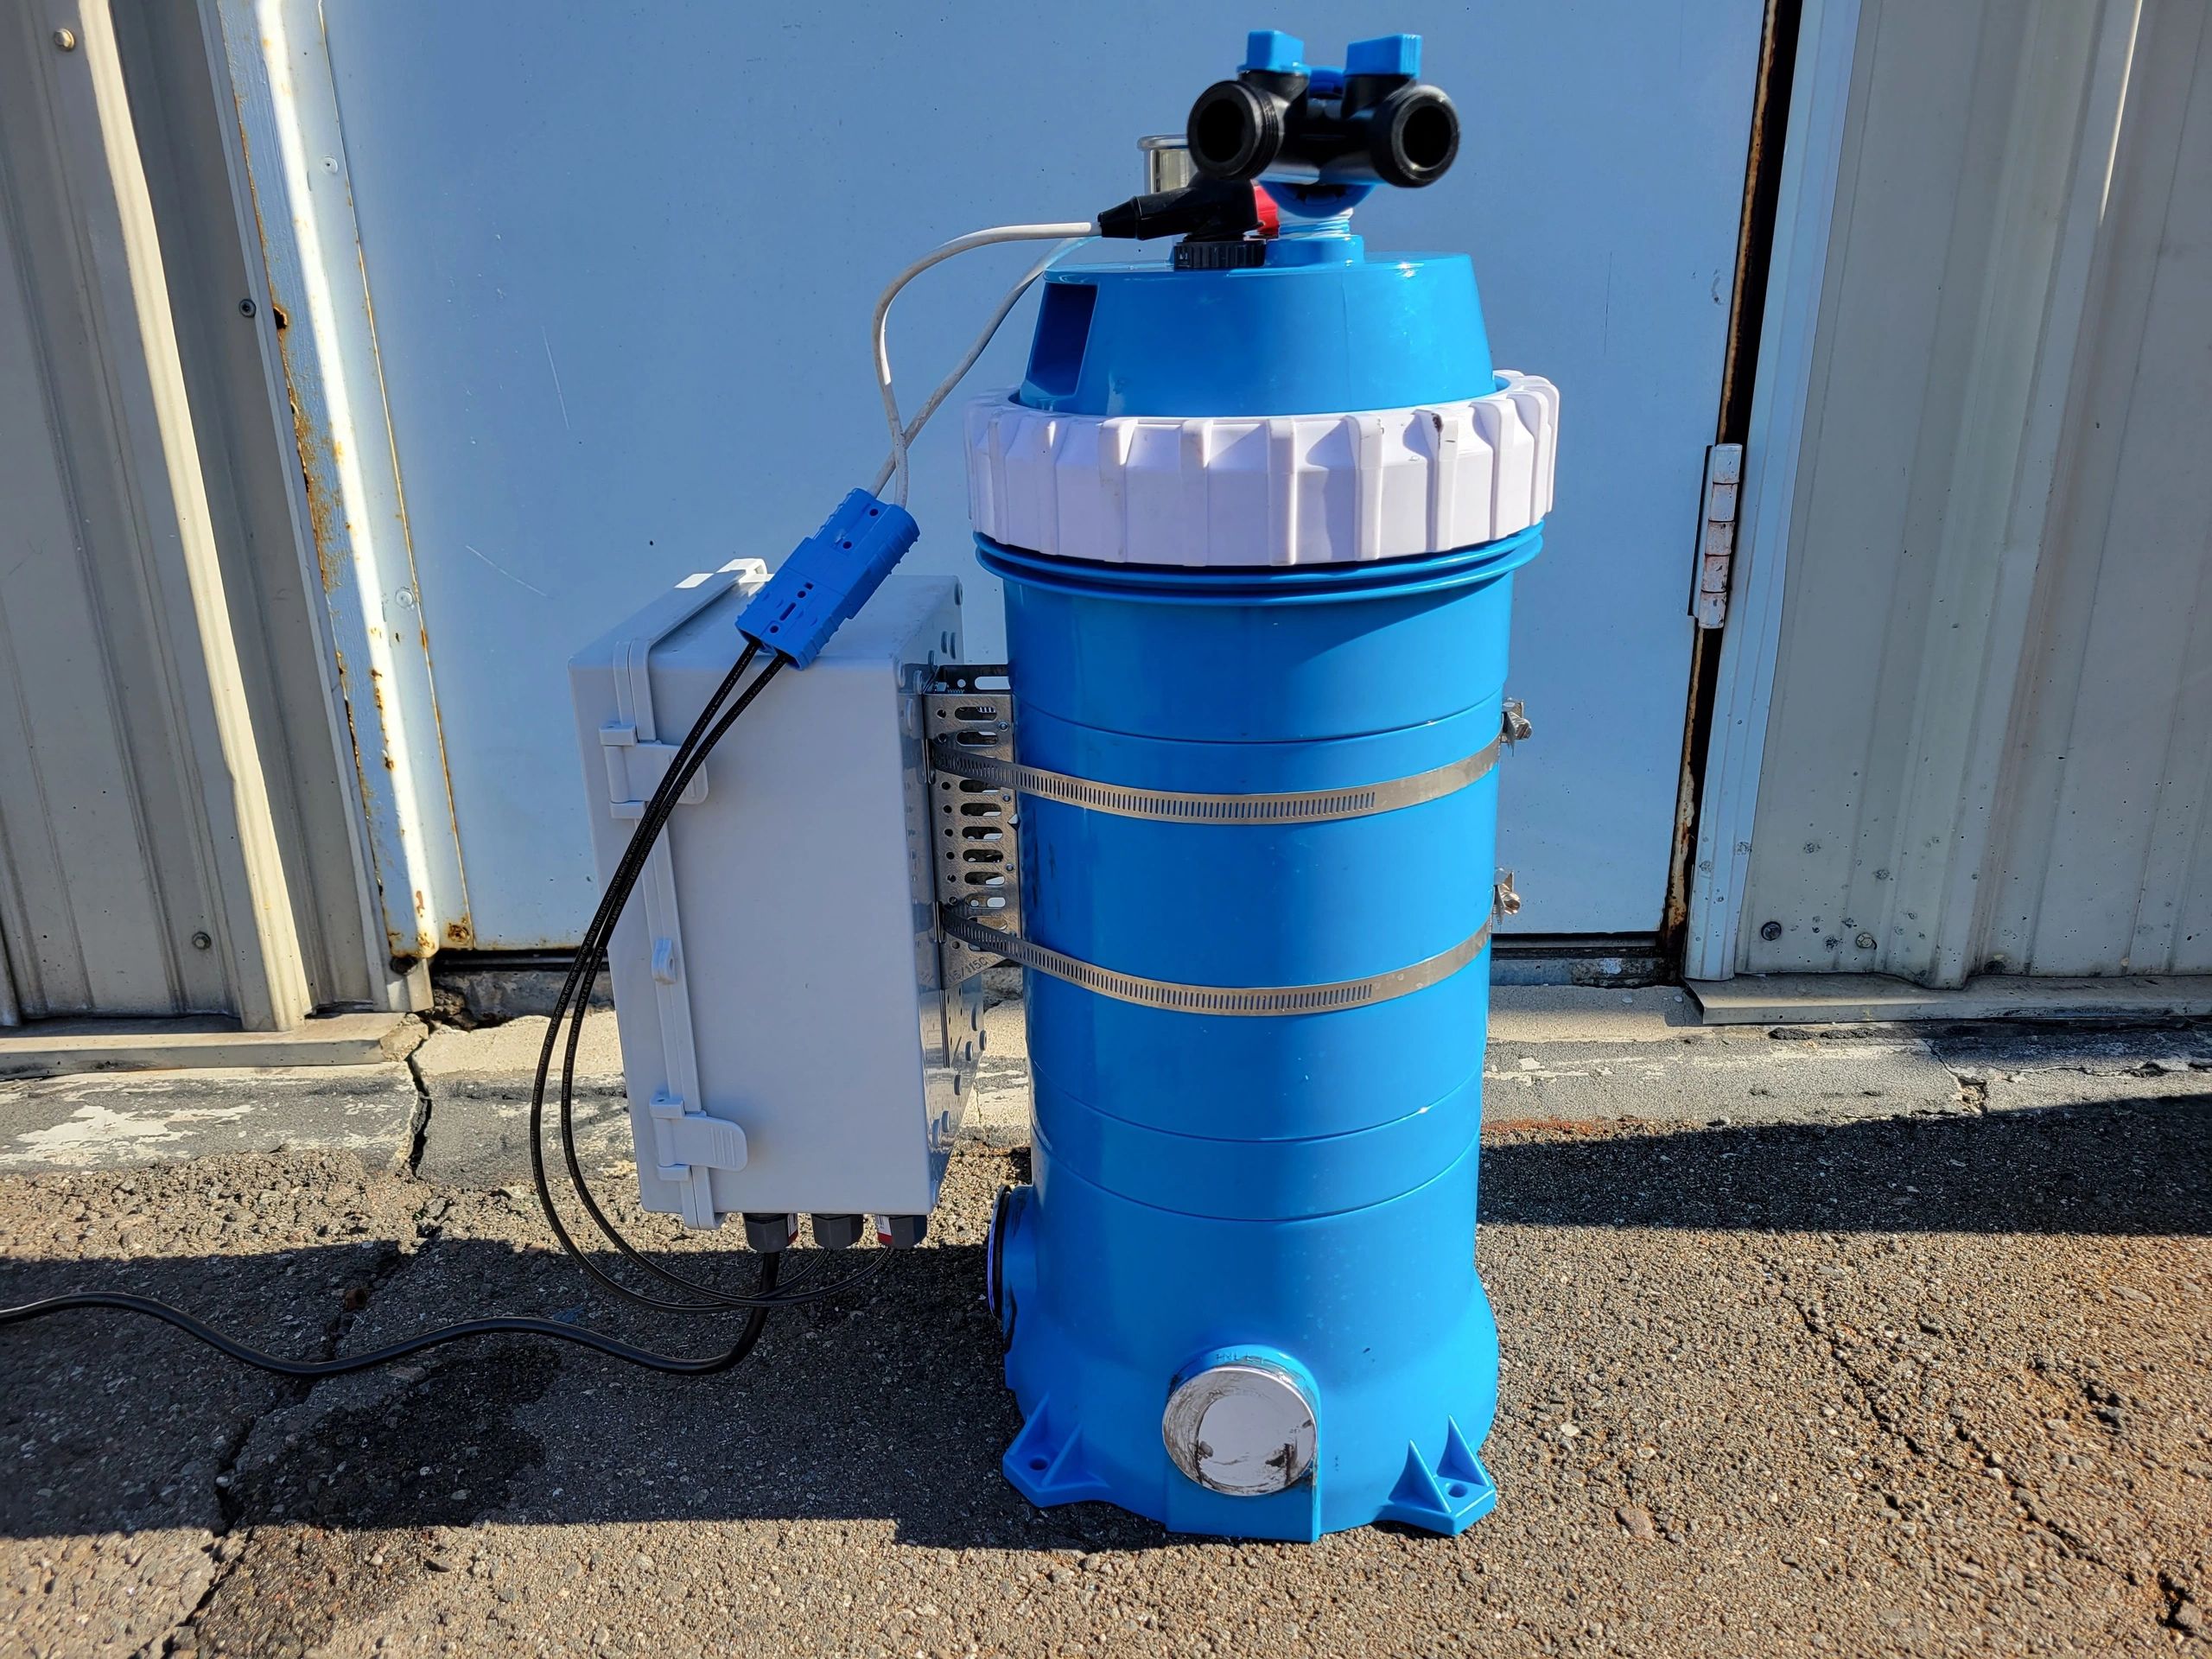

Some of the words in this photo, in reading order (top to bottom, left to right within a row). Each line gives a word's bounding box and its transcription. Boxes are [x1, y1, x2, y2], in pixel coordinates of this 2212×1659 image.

[563, 980, 574, 995] MTW
[569, 970, 578, 981] OR
[582, 945, 589, 955] OR
[586, 930, 595, 945] AWM
